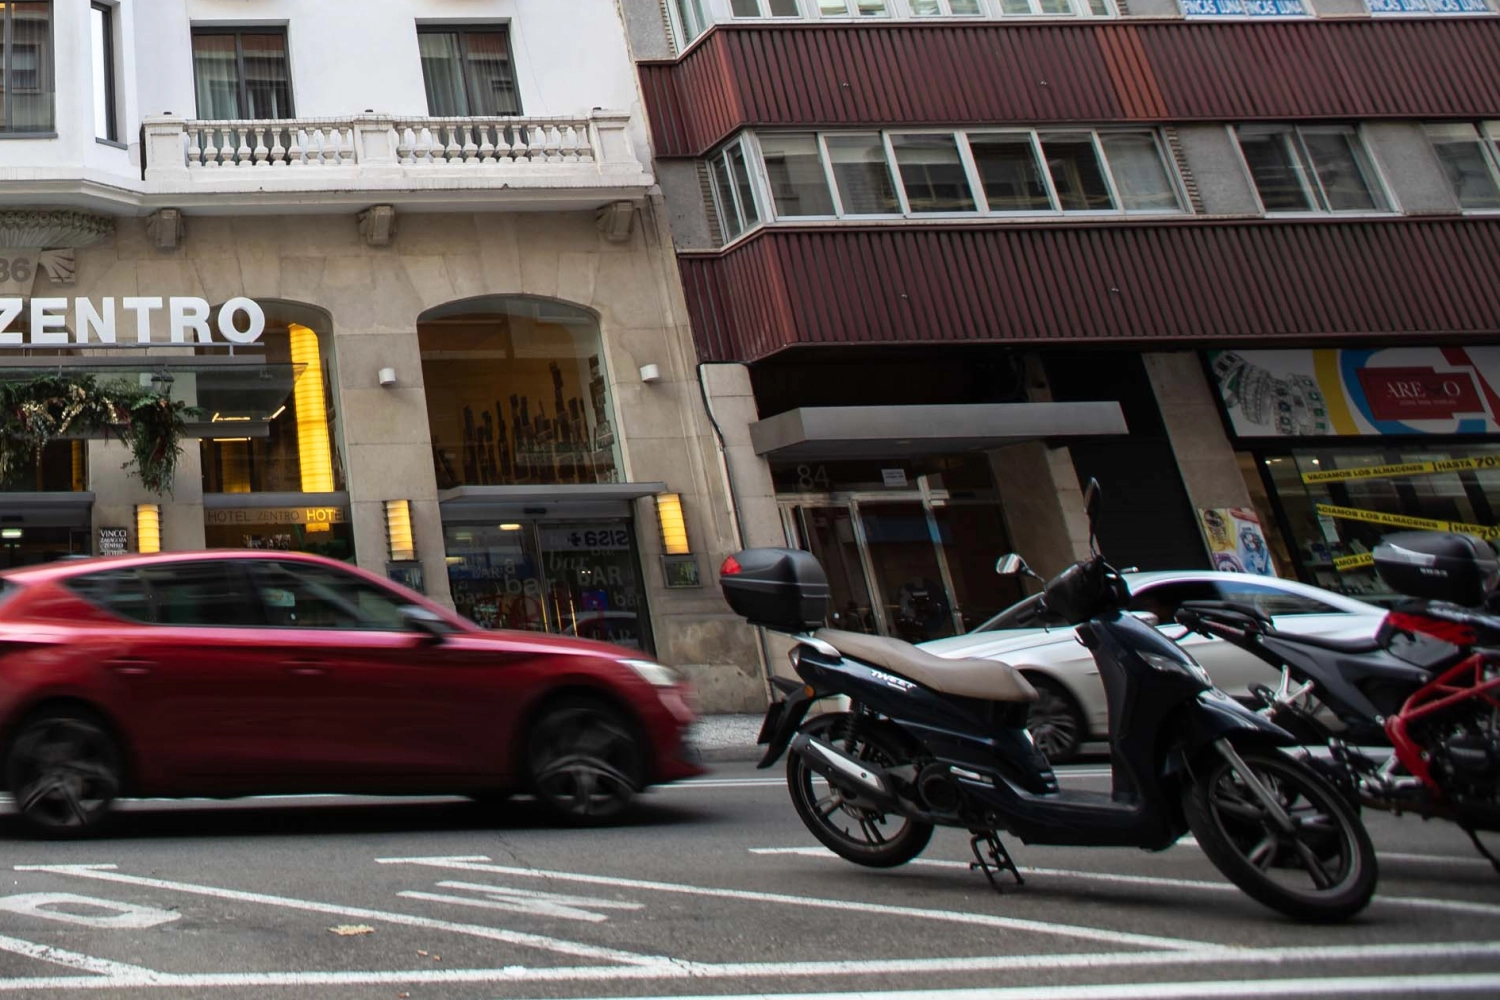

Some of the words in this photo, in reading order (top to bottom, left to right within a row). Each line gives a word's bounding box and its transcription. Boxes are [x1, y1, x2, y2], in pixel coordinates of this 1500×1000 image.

[797, 464, 830, 489] 84
[1307, 471, 1351, 481] VACIAMOS
[1353, 469, 1371, 477] LOS
[1373, 464, 1424, 475] ALMACENES
[1438, 460, 1472, 470] HASTA
[207, 511, 248, 523] HOTEL
[257, 511, 300, 521] ZENTRO
[306, 508, 349, 521] HOTEL
[1360, 511, 1379, 520] LOS
[1381, 515, 1438, 528] ALMACENES
[871, 670, 917, 688] TWEET
